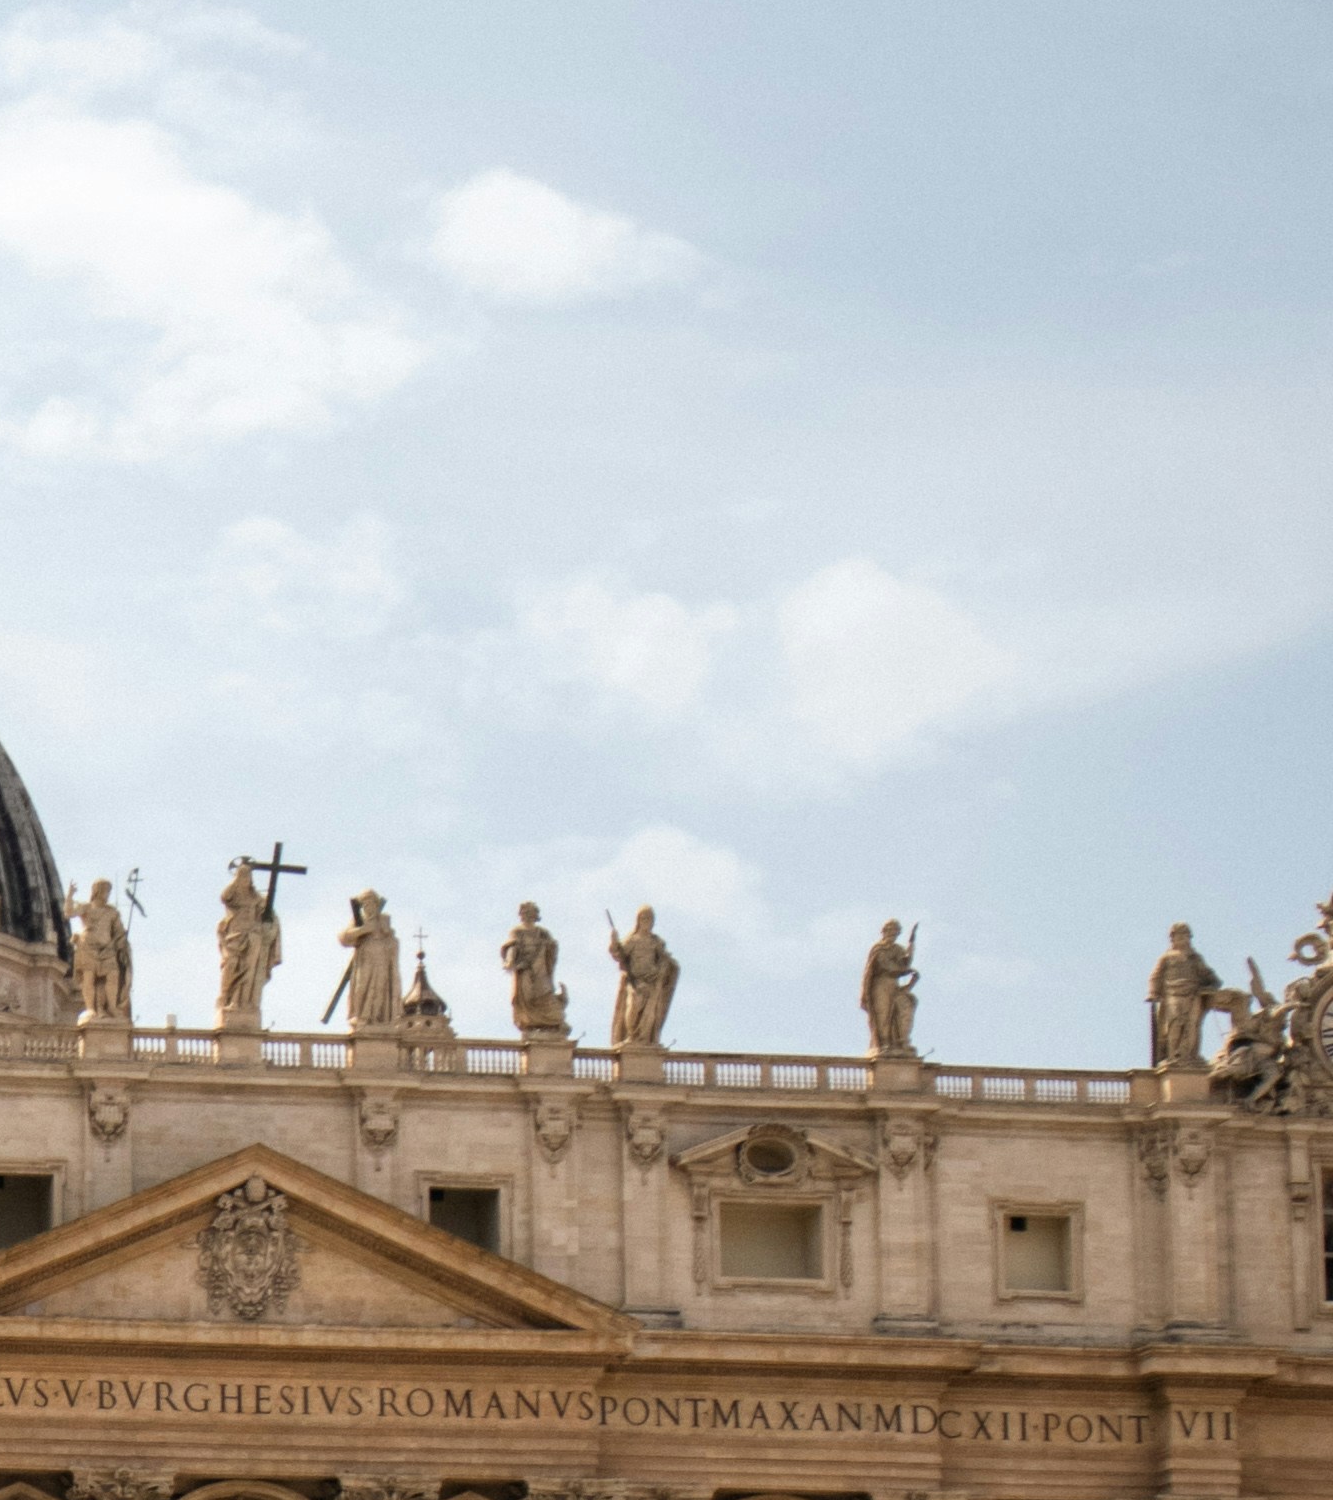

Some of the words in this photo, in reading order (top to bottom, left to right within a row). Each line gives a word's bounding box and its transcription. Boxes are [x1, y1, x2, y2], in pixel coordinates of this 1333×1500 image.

[59, 1378, 85, 1409] V
[97, 1378, 363, 1417] BVRGHESIVS
[378, 1387, 594, 1421] ROMANVS
[598, 1395, 707, 1429] PONT
[712, 1399, 803, 1431] MAX
[807, 1402, 863, 1433] AN
[873, 1403, 1028, 1442] MDCXII
[1042, 1412, 1149, 1444] PONT
[1175, 1410, 1233, 1441] VII
